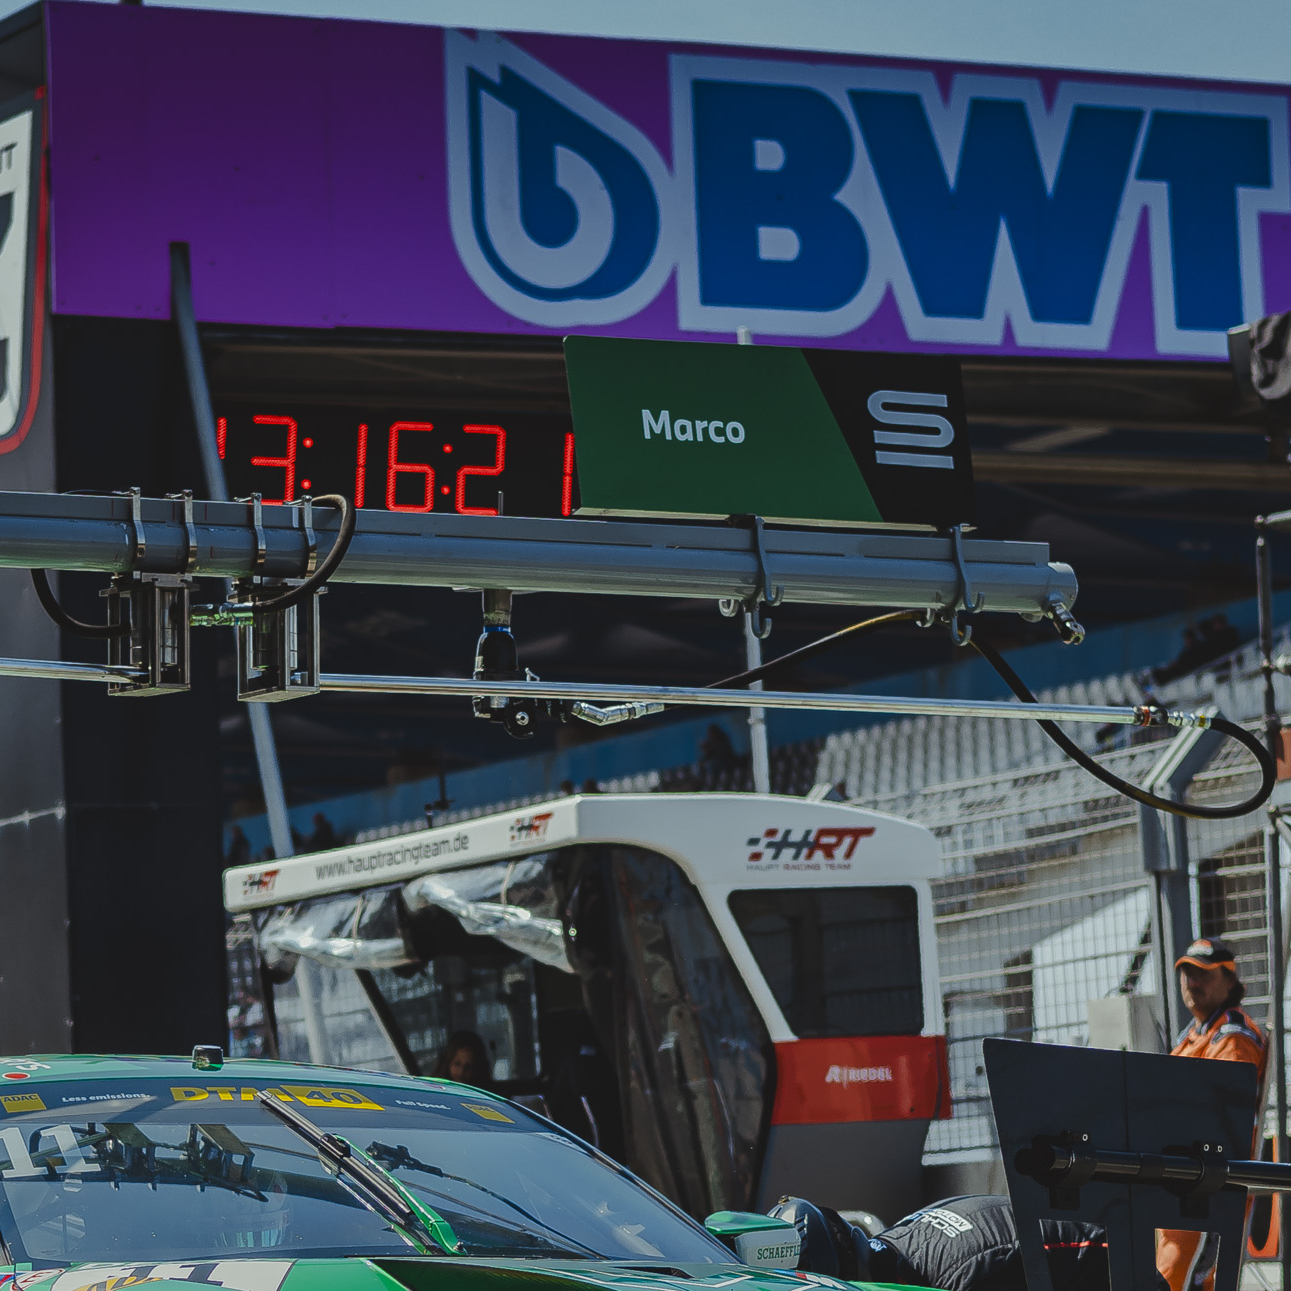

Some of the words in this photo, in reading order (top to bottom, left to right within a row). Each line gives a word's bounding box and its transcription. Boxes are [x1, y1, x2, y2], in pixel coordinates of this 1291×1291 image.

[682, 67, 1283, 342] BWT
[642, 409, 746, 443] Marco
[763, 826, 877, 861] HRT
[315, 833, 470, 881] www.hauptracingteam.de
[746, 863, 779, 872] HAUPT
[783, 863, 822, 871] RACING
[825, 862, 852, 871] TEAM
[3, 1093, 39, 1104] ADAC
[61, 1095, 87, 1103] Less
[89, 1092, 150, 1101] emissions.
[170, 1086, 296, 1102] DTM
[306, 1089, 366, 1106] 40
[757, 1245, 801, 1260] SCHAEFFLE
